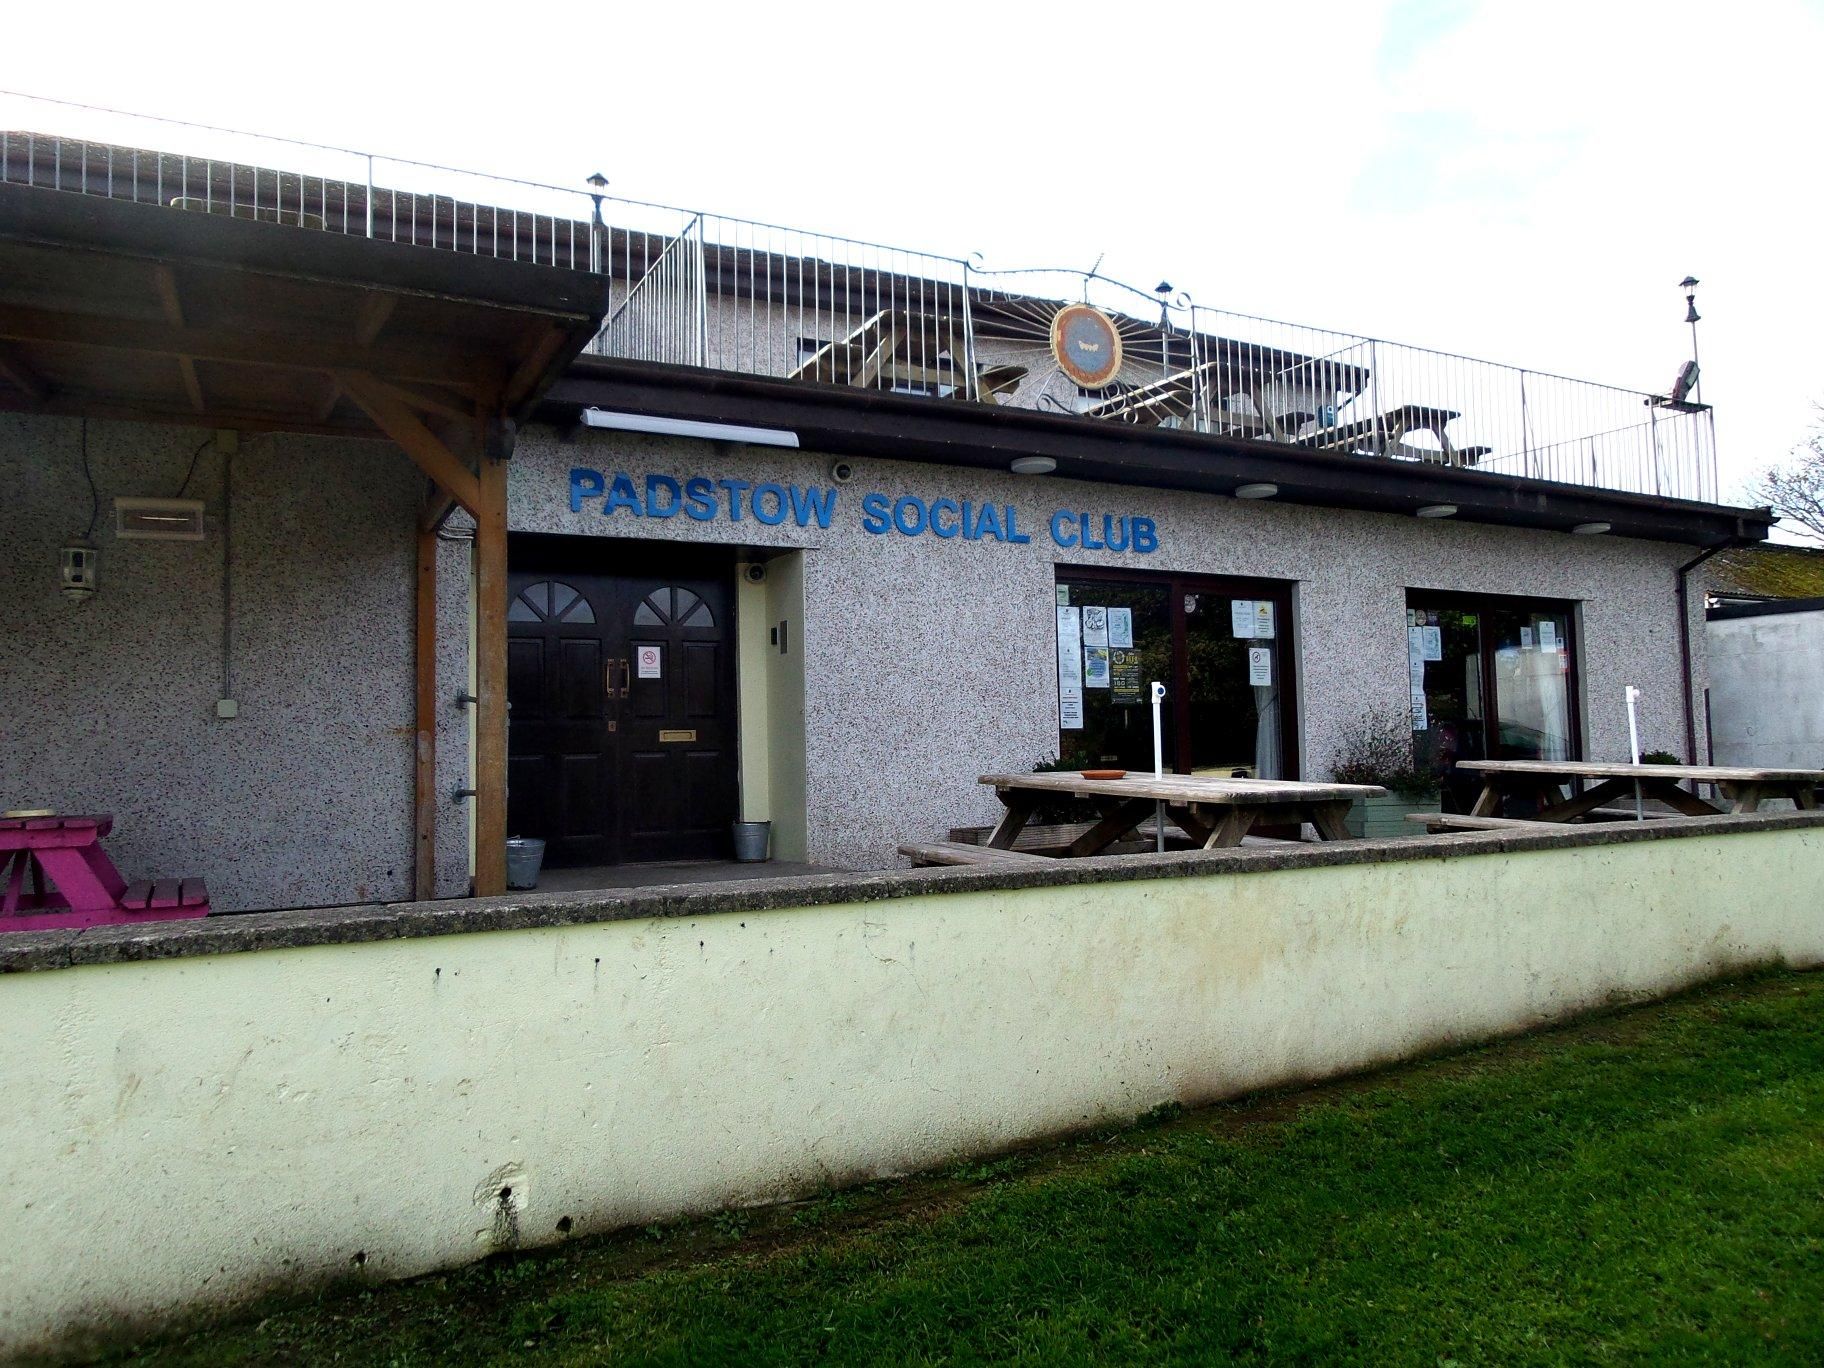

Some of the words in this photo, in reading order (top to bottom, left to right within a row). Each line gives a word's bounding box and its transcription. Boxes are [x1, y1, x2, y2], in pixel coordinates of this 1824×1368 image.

[568, 466, 838, 529] PADSTOW
[861, 492, 1031, 545] SOCIAL
[1049, 508, 1160, 554] CLUB
